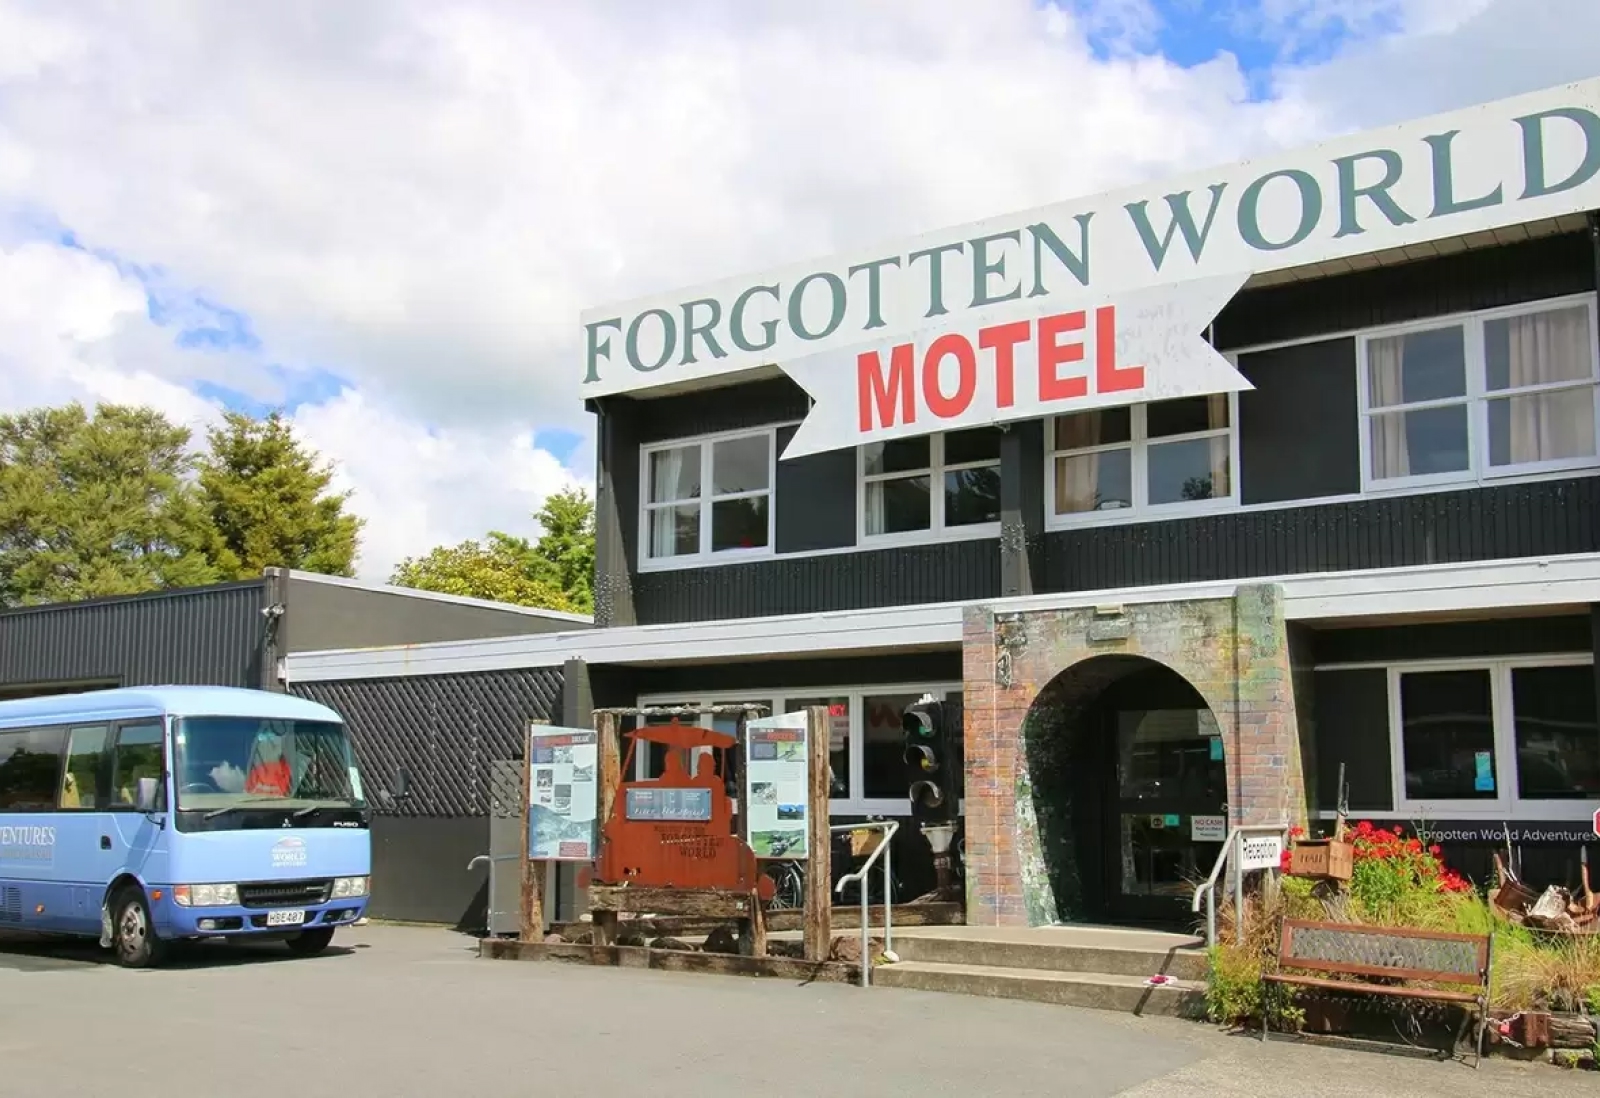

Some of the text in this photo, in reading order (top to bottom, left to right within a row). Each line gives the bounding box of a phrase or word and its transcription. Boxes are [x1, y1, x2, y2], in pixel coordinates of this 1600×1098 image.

[582, 107, 1600, 385] FORGOTTEN WORLD
[857, 305, 1144, 433] MOTEL
[1243, 837, 1278, 863] Reception
[1417, 827, 1597, 842] Forgotten Word Adventures
